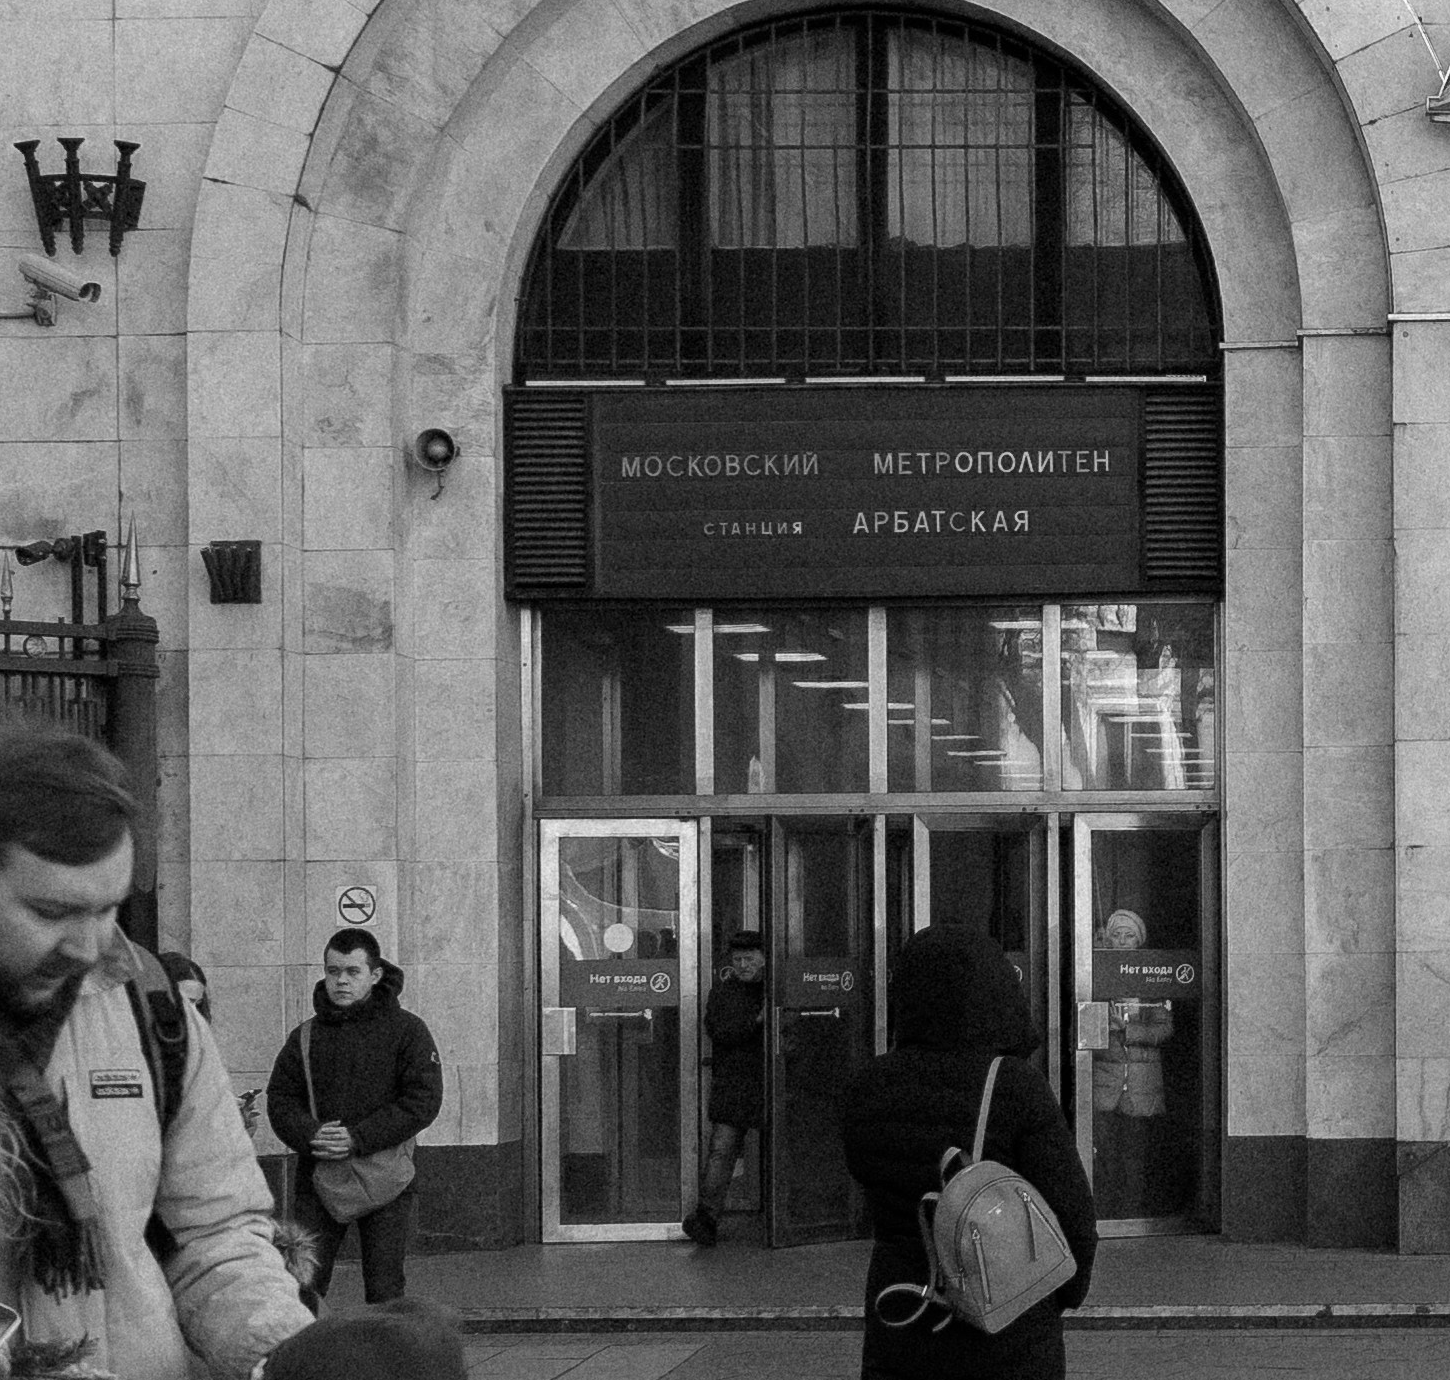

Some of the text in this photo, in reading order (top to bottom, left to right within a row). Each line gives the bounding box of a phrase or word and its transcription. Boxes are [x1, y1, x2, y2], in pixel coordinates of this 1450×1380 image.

[621, 450, 1110, 478] МОСКОВСКИЙ МЕТРОПОЛИТЕН
[703, 509, 1029, 536] СТАНЦИЯ АРБАТСКАЯ
[1119, 963, 1173, 975] Нет входа
[589, 973, 647, 985] Нет входа
